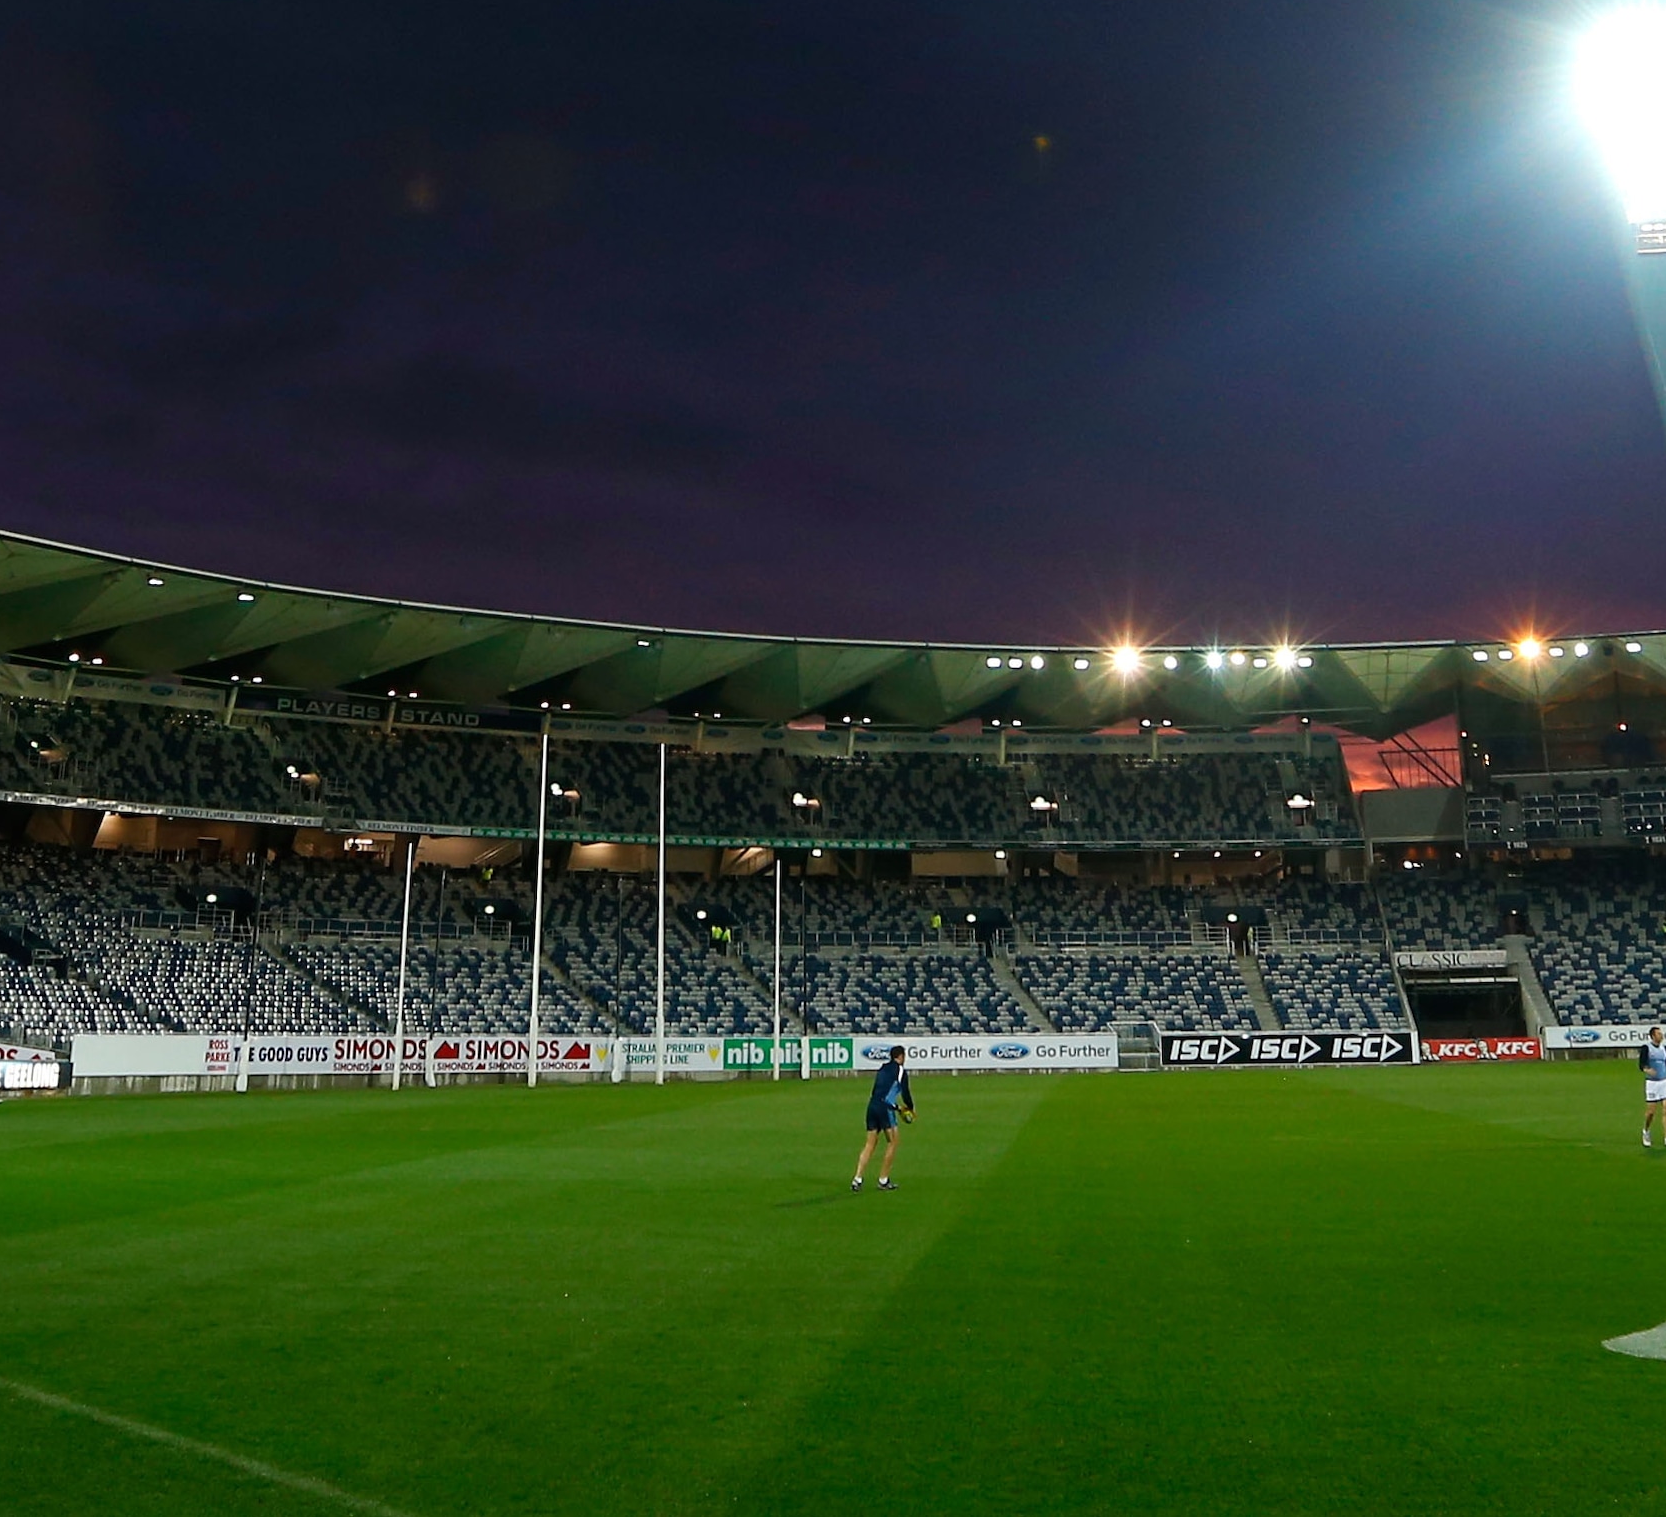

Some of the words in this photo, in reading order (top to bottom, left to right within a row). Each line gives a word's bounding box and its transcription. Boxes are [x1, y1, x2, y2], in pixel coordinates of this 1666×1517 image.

[276, 696, 382, 720] PLAYERS
[400, 708, 480, 727] STAND
[1608, 1030, 1627, 1042] Go
[209, 1039, 229, 1050] ROSS
[334, 1039, 427, 1060] SIMONDS
[465, 1039, 560, 1060] SIMONDS
[666, 1044, 705, 1054] PREMIER
[727, 1040, 764, 1065] nib
[812, 1040, 849, 1065] nib
[907, 1046, 928, 1059] Go
[931, 1045, 982, 1059] Further
[994, 1044, 1026, 1059] Ford
[1036, 1045, 1057, 1058] Go
[1059, 1044, 1110, 1058] Further
[1170, 1039, 1219, 1061] ISC
[1250, 1038, 1299, 1060] ISC
[1331, 1037, 1382, 1059] ISC
[1438, 1043, 1477, 1057] KFC
[1496, 1041, 1535, 1055] KFC
[234, 1047, 255, 1062] TE
[258, 1047, 293, 1062] GOOD
[297, 1047, 329, 1062] GUYS
[626, 1055, 668, 1065] SHIPPIG
[670, 1055, 689, 1065] LINE
[333, 1062, 370, 1072] SIMONDS
[385, 1062, 423, 1071] SIONDS
[437, 1062, 474, 1071] SIMONDS
[488, 1062, 526, 1071] SIMONDS
[541, 1061, 578, 1071] SIMONDS
[3, 1062, 60, 1089] GEELONG
